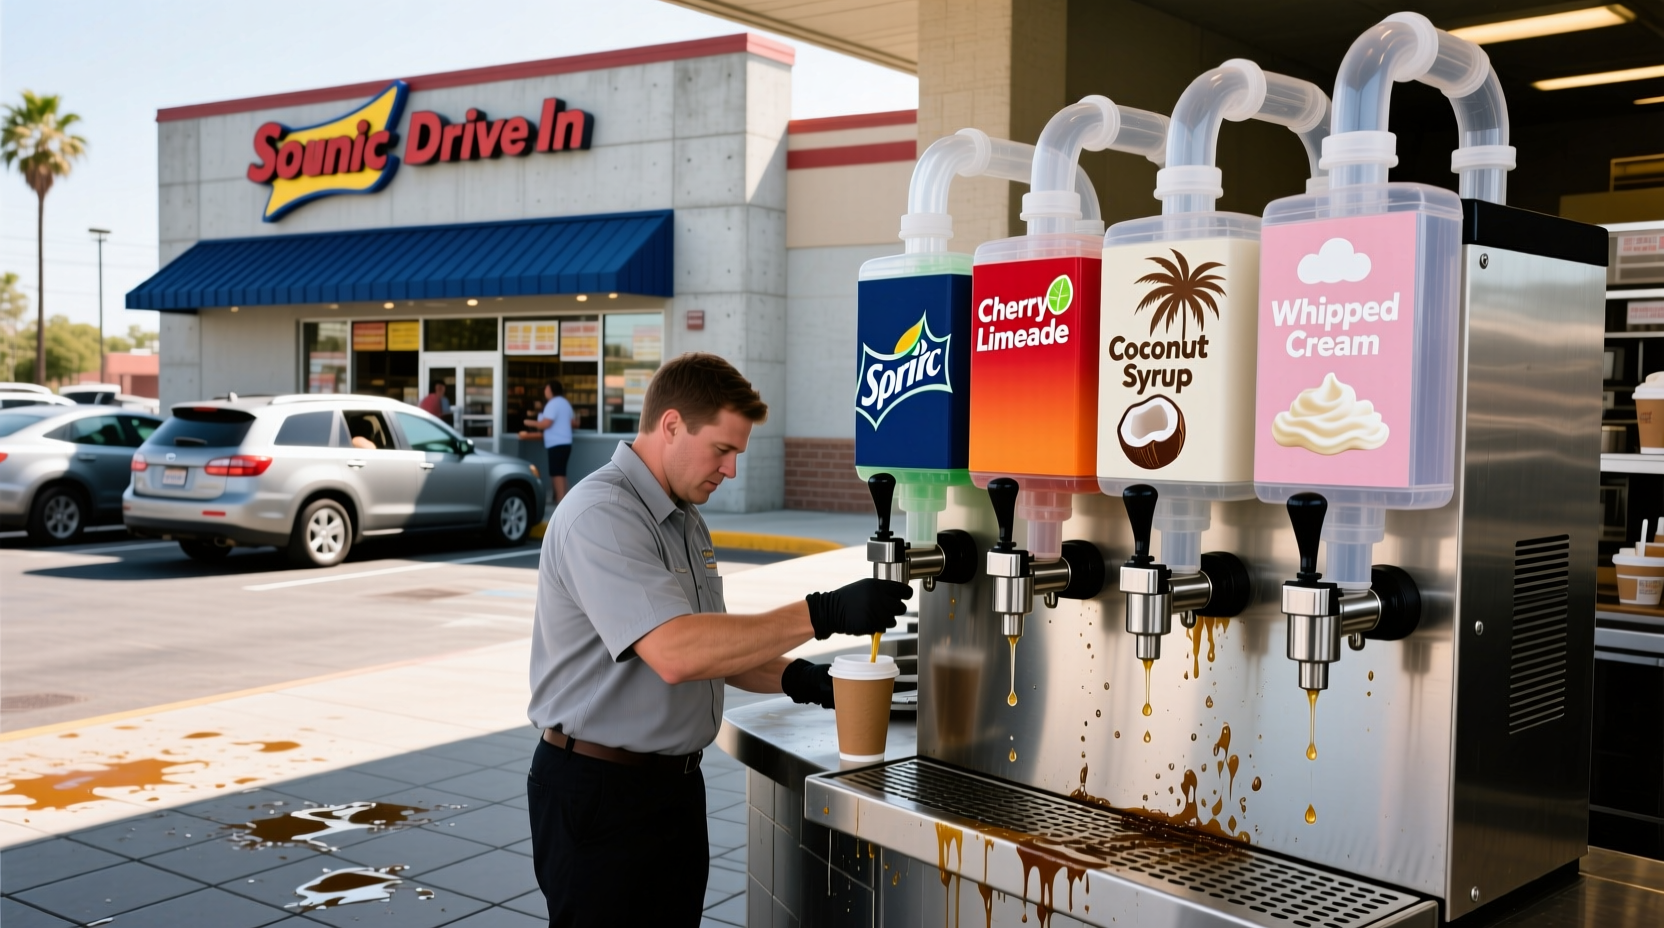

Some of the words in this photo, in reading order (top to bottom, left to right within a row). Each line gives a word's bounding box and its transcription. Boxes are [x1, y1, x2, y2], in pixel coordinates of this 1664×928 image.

[403, 107, 533, 166] Drive
[536, 97, 590, 153] In
[978, 296, 1048, 323] Cherry
[1271, 291, 1400, 331] Whipped
[976, 317, 1069, 352] Limeade
[1108, 334, 1209, 361] Coconut
[1285, 330, 1379, 358] Cream
[1122, 363, 1193, 395] Syrup
